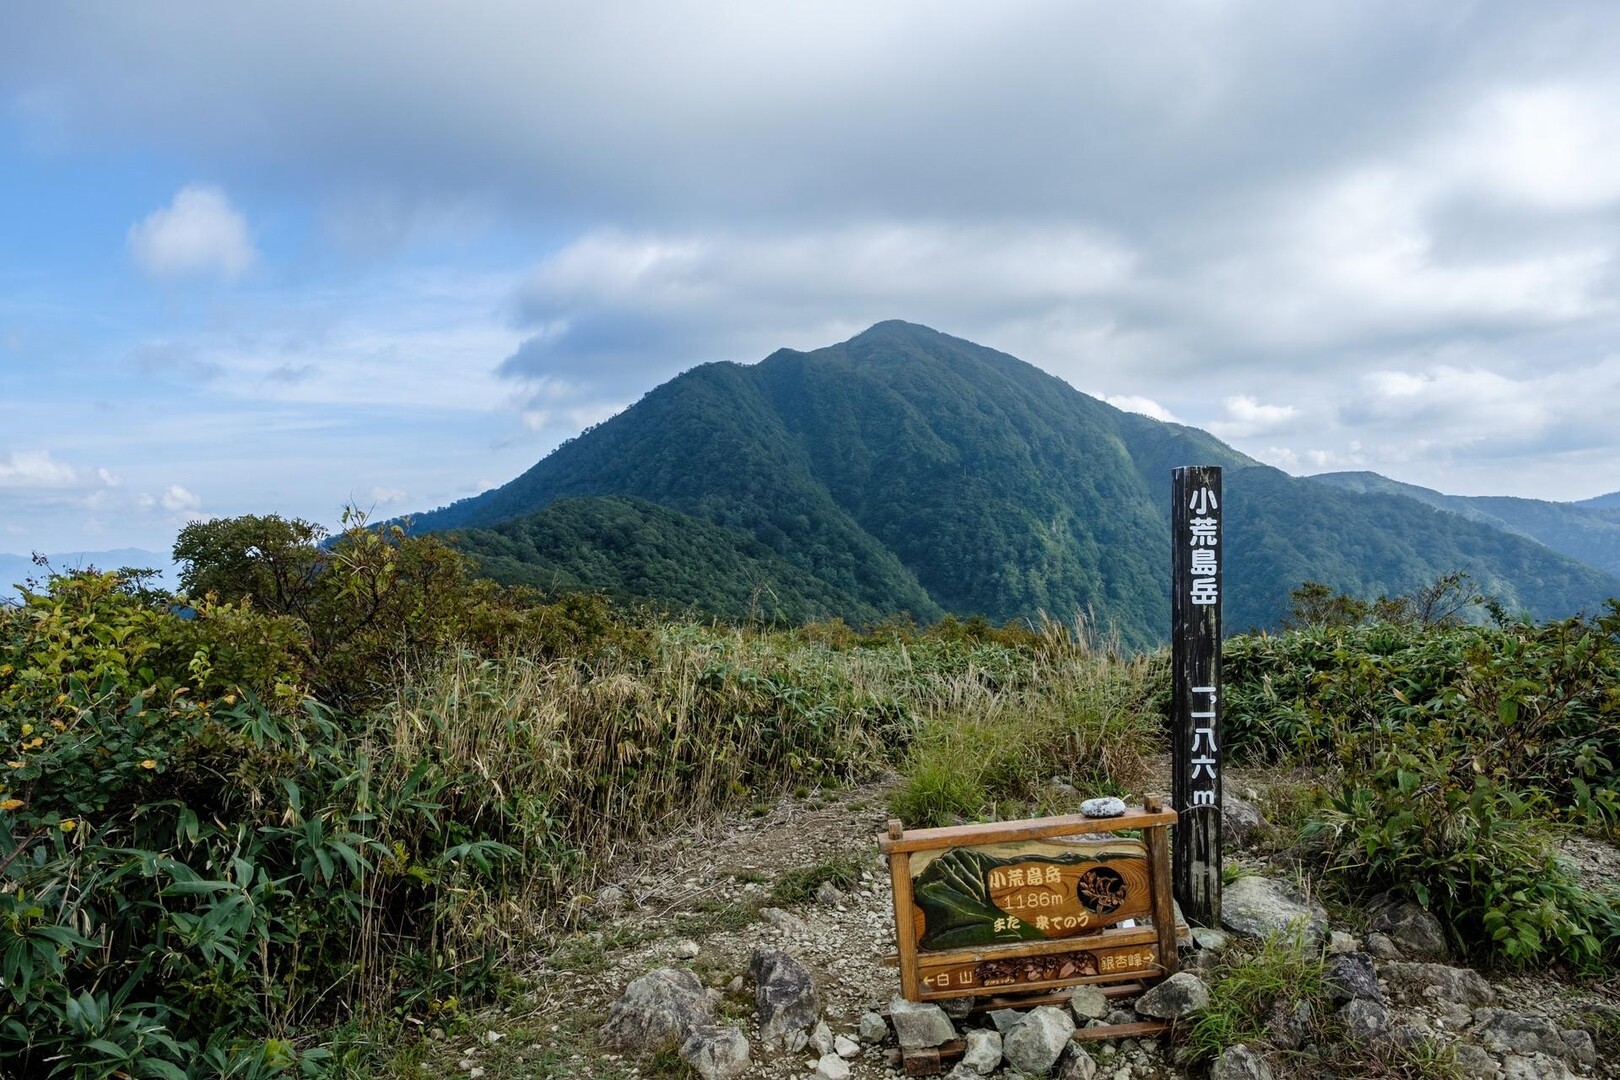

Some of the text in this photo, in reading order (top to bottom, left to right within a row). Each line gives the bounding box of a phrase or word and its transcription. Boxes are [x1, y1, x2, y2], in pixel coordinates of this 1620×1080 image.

[1189, 487, 1218, 605] 小荒島岳
[989, 866, 1062, 888] 小荒島岳
[1004, 892, 1063, 910] 1186m
[993, 915, 1021, 932] また
[1101, 953, 1142, 970] 銀杏峰
